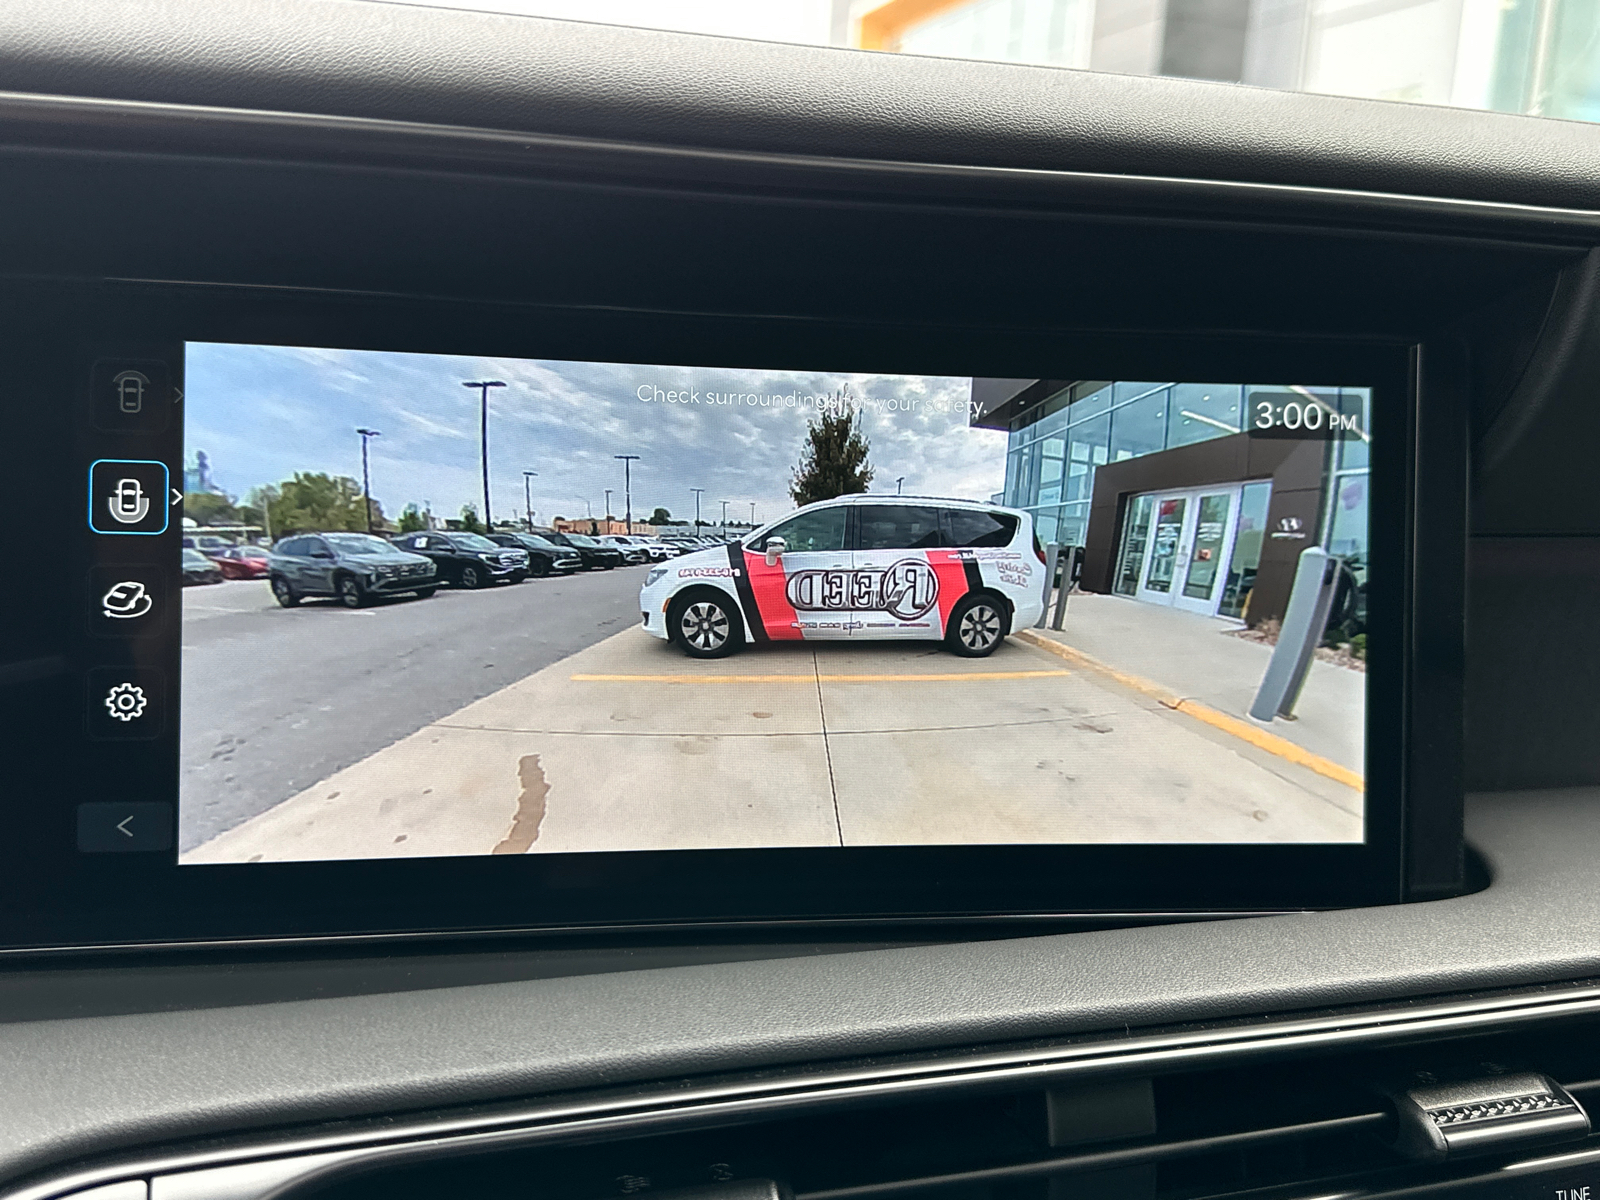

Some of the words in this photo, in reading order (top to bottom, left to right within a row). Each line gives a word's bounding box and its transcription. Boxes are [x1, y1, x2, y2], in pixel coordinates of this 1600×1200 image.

[636, 384, 700, 405] Check
[705, 389, 837, 413] surroundings
[843, 393, 871, 410] for
[876, 398, 919, 415] your
[925, 397, 988, 418] safety.
[1255, 401, 1321, 430] 3:00
[1329, 414, 1356, 430] PM
[1555, 1186, 1591, 1200] TUNE
